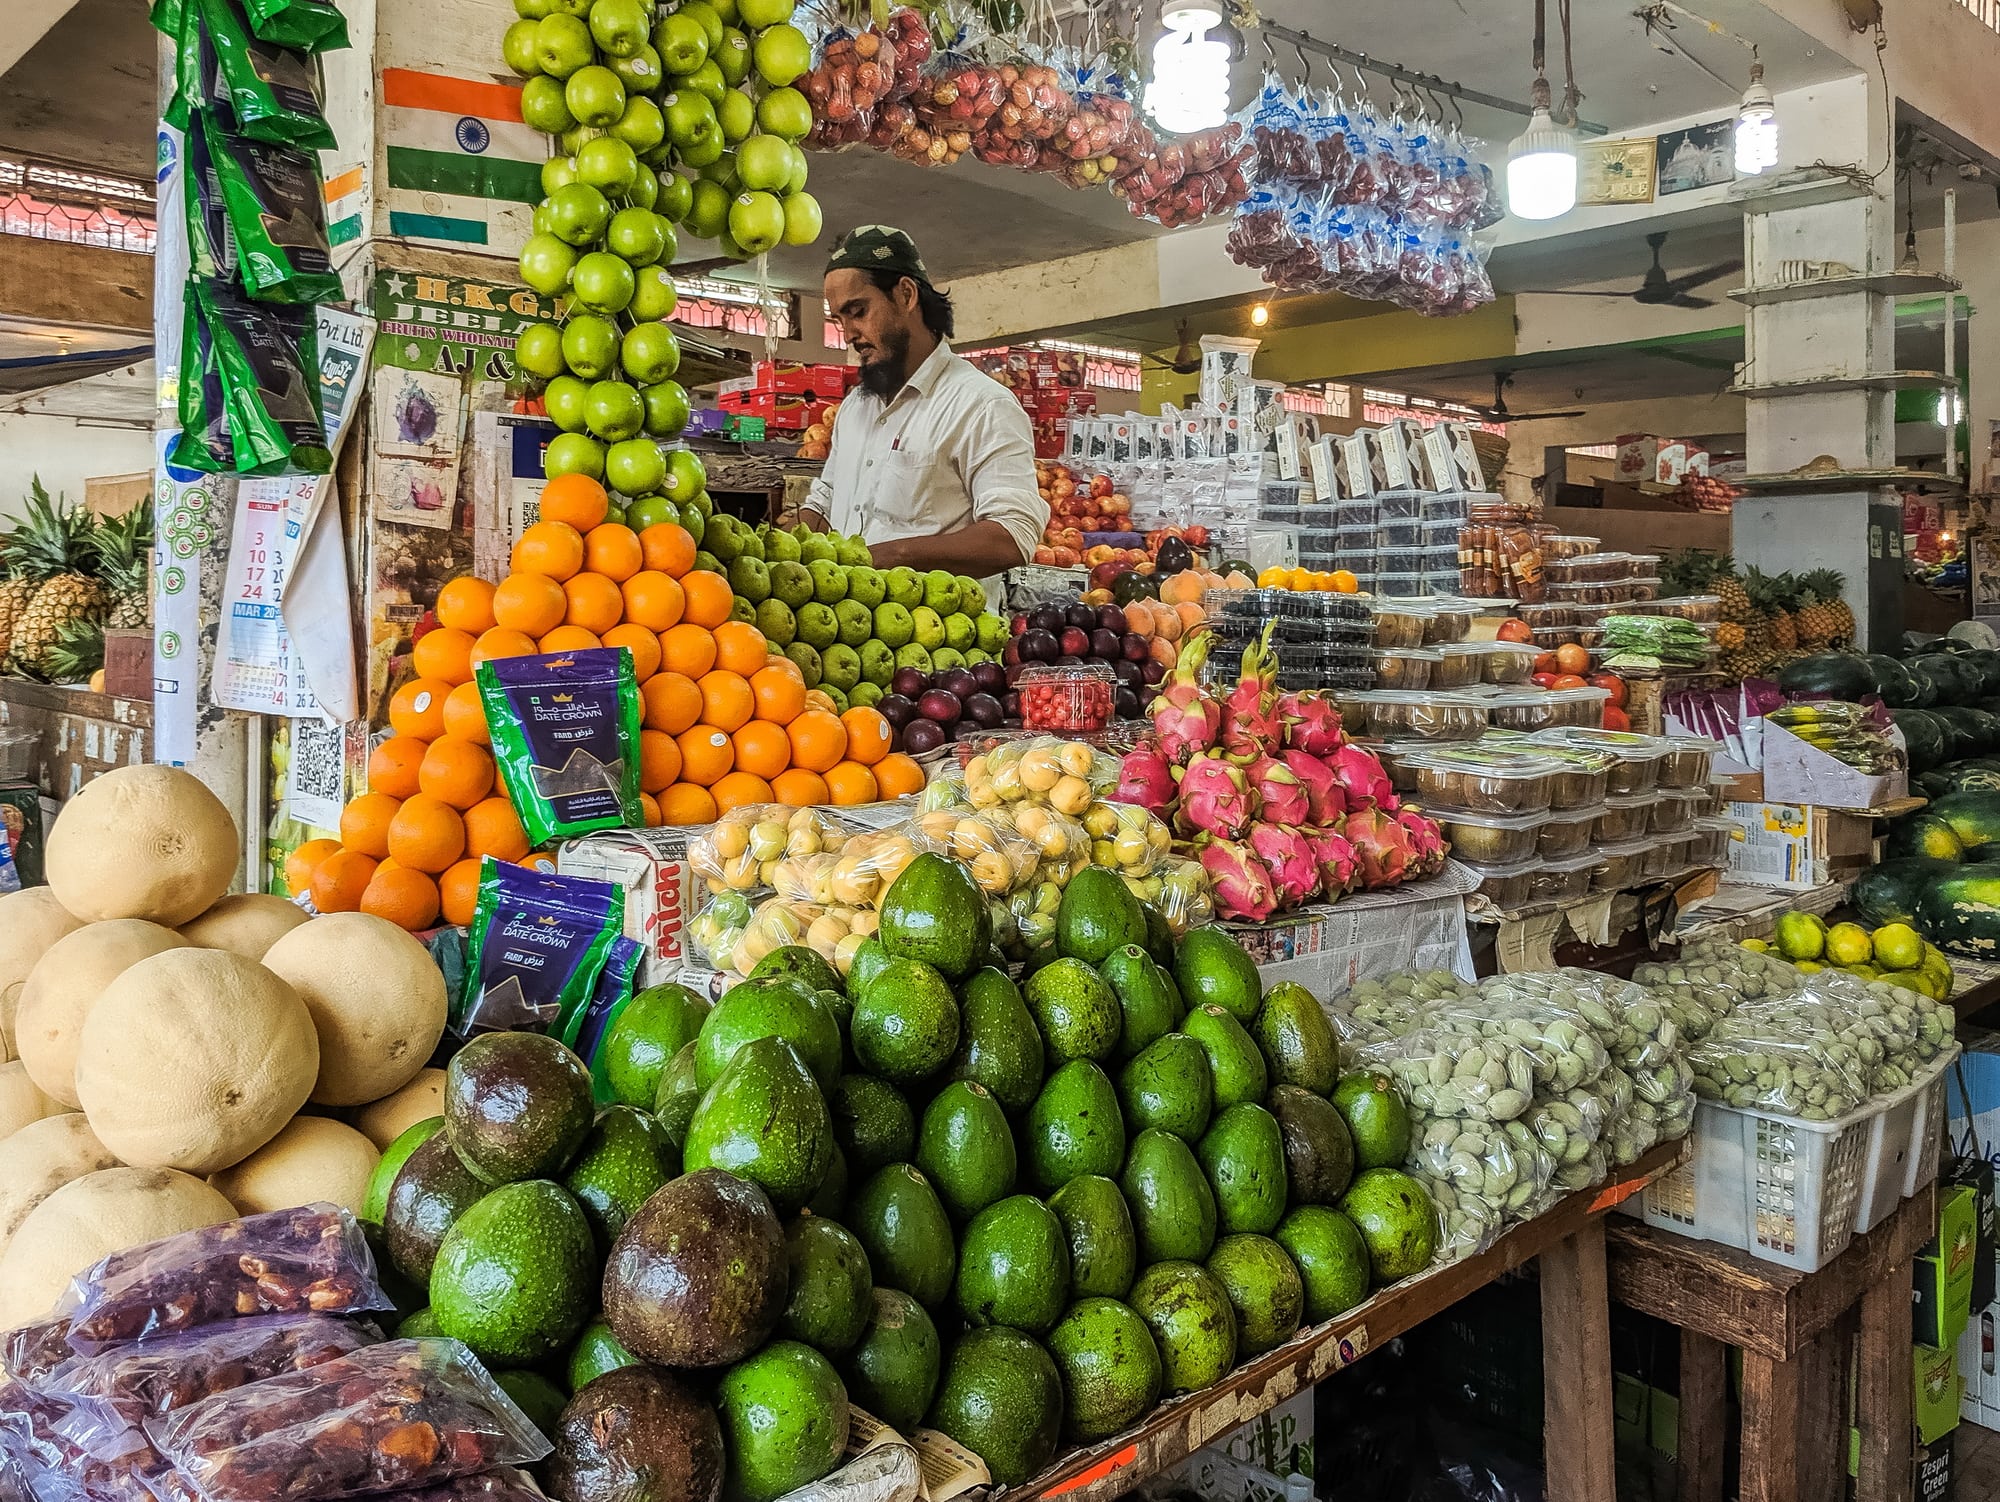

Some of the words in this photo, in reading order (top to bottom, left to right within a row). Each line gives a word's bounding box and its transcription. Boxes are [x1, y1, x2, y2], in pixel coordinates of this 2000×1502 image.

[318, 319, 340, 341] Pvt.
[342, 325, 364, 349] Ltd.
[381, 320, 437, 340] FRUITS
[252, 338, 275, 348] DATE
[431, 344, 479, 375] AJ
[485, 351, 516, 382] &
[296, 483, 314, 500] 26
[256, 503, 273, 511] SUN
[255, 532, 264, 546] 3
[249, 549, 266, 564] 10
[247, 566, 265, 581] 17
[241, 584, 263, 599] 24
[273, 587, 282, 602] 2
[235, 603, 260, 617] MAR
[297, 674, 306, 689] 19
[296, 693, 306, 708] 26
[535, 712, 561, 722] DATE
[562, 708, 603, 721] CROWN
[502, 925, 528, 941] DATE
[529, 931, 570, 949] CROWN
[504, 951, 523, 962] FARD
[1921, 1449, 1949, 1479] Zespri
[1923, 1470, 1949, 1495] Green
